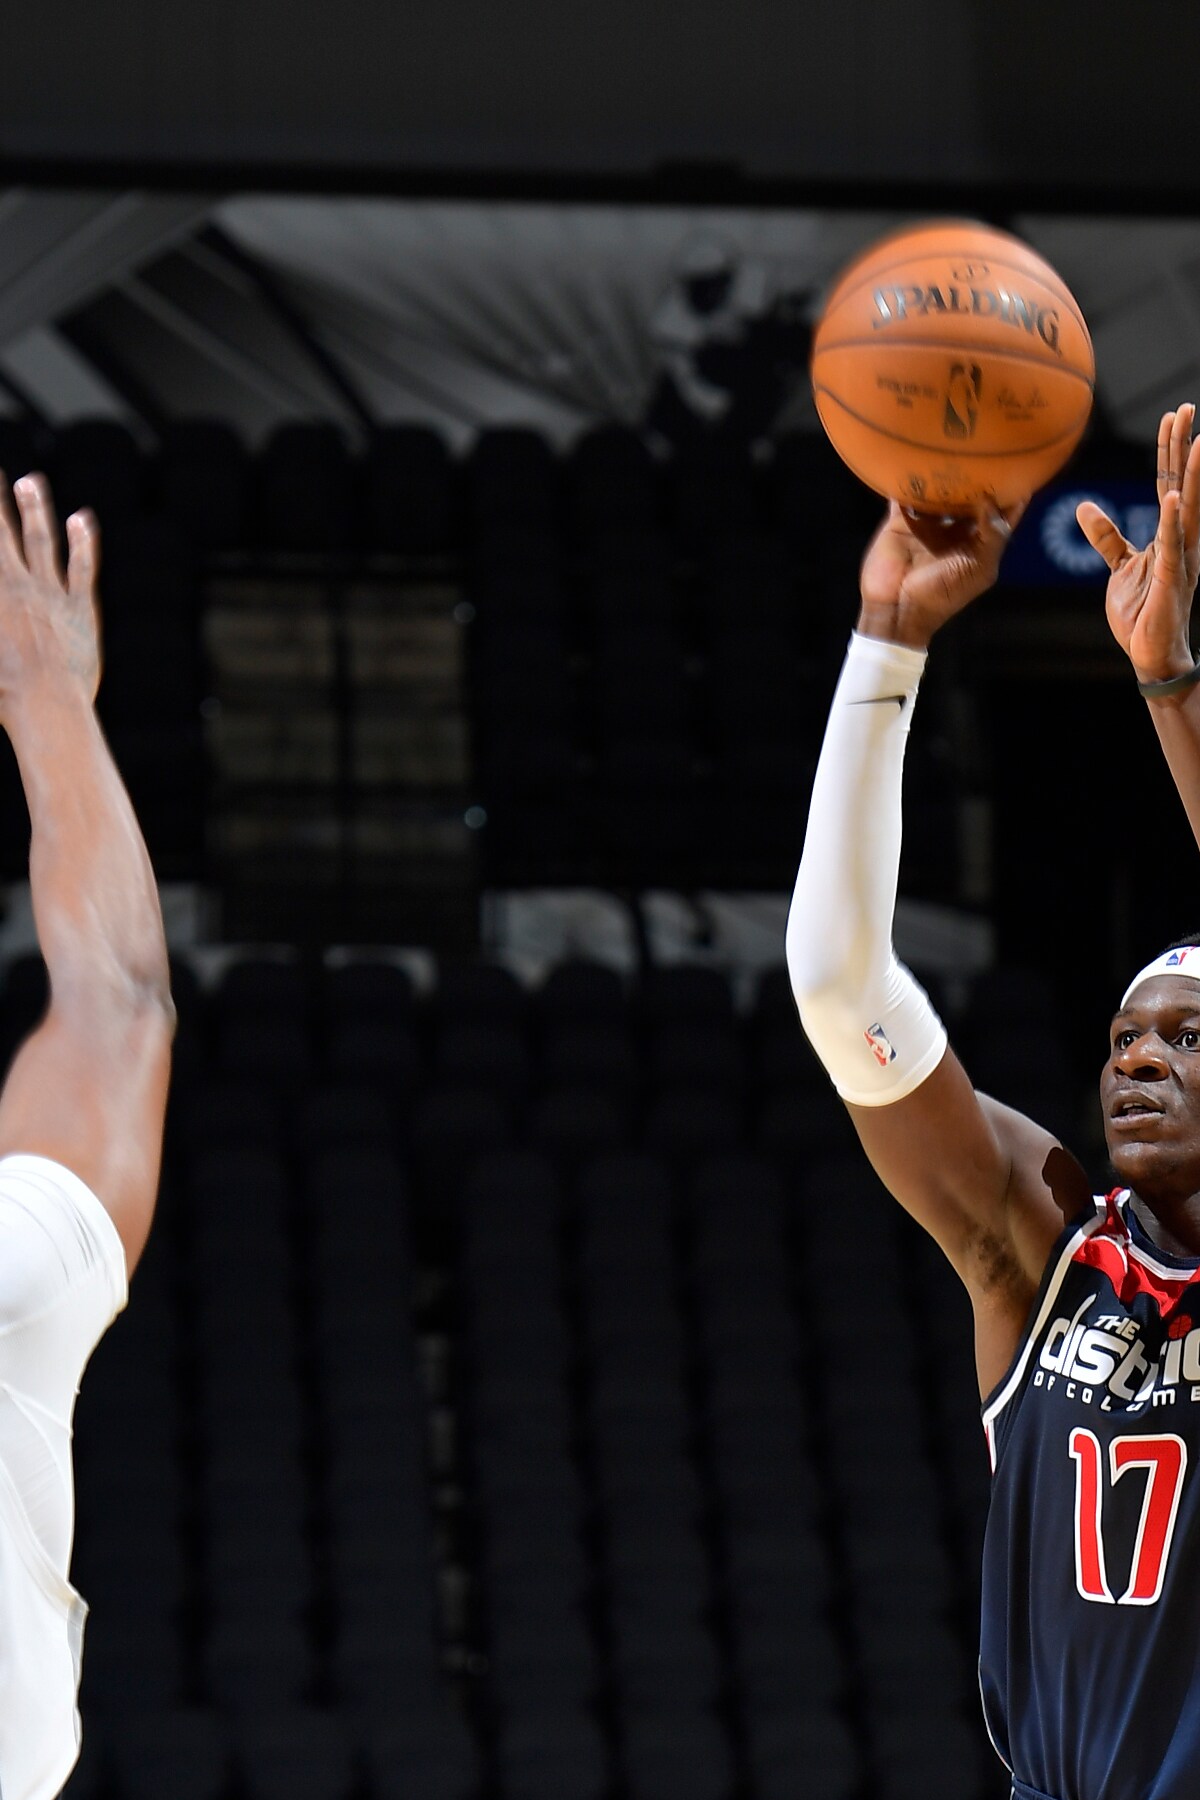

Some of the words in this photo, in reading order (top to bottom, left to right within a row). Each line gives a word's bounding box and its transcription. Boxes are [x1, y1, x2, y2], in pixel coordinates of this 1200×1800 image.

[872, 285, 1062, 357] SPALDING
[1097, 1315, 1141, 1341] THE
[1033, 1371, 1056, 1391] OF
[1068, 1426, 1189, 1606] 17
